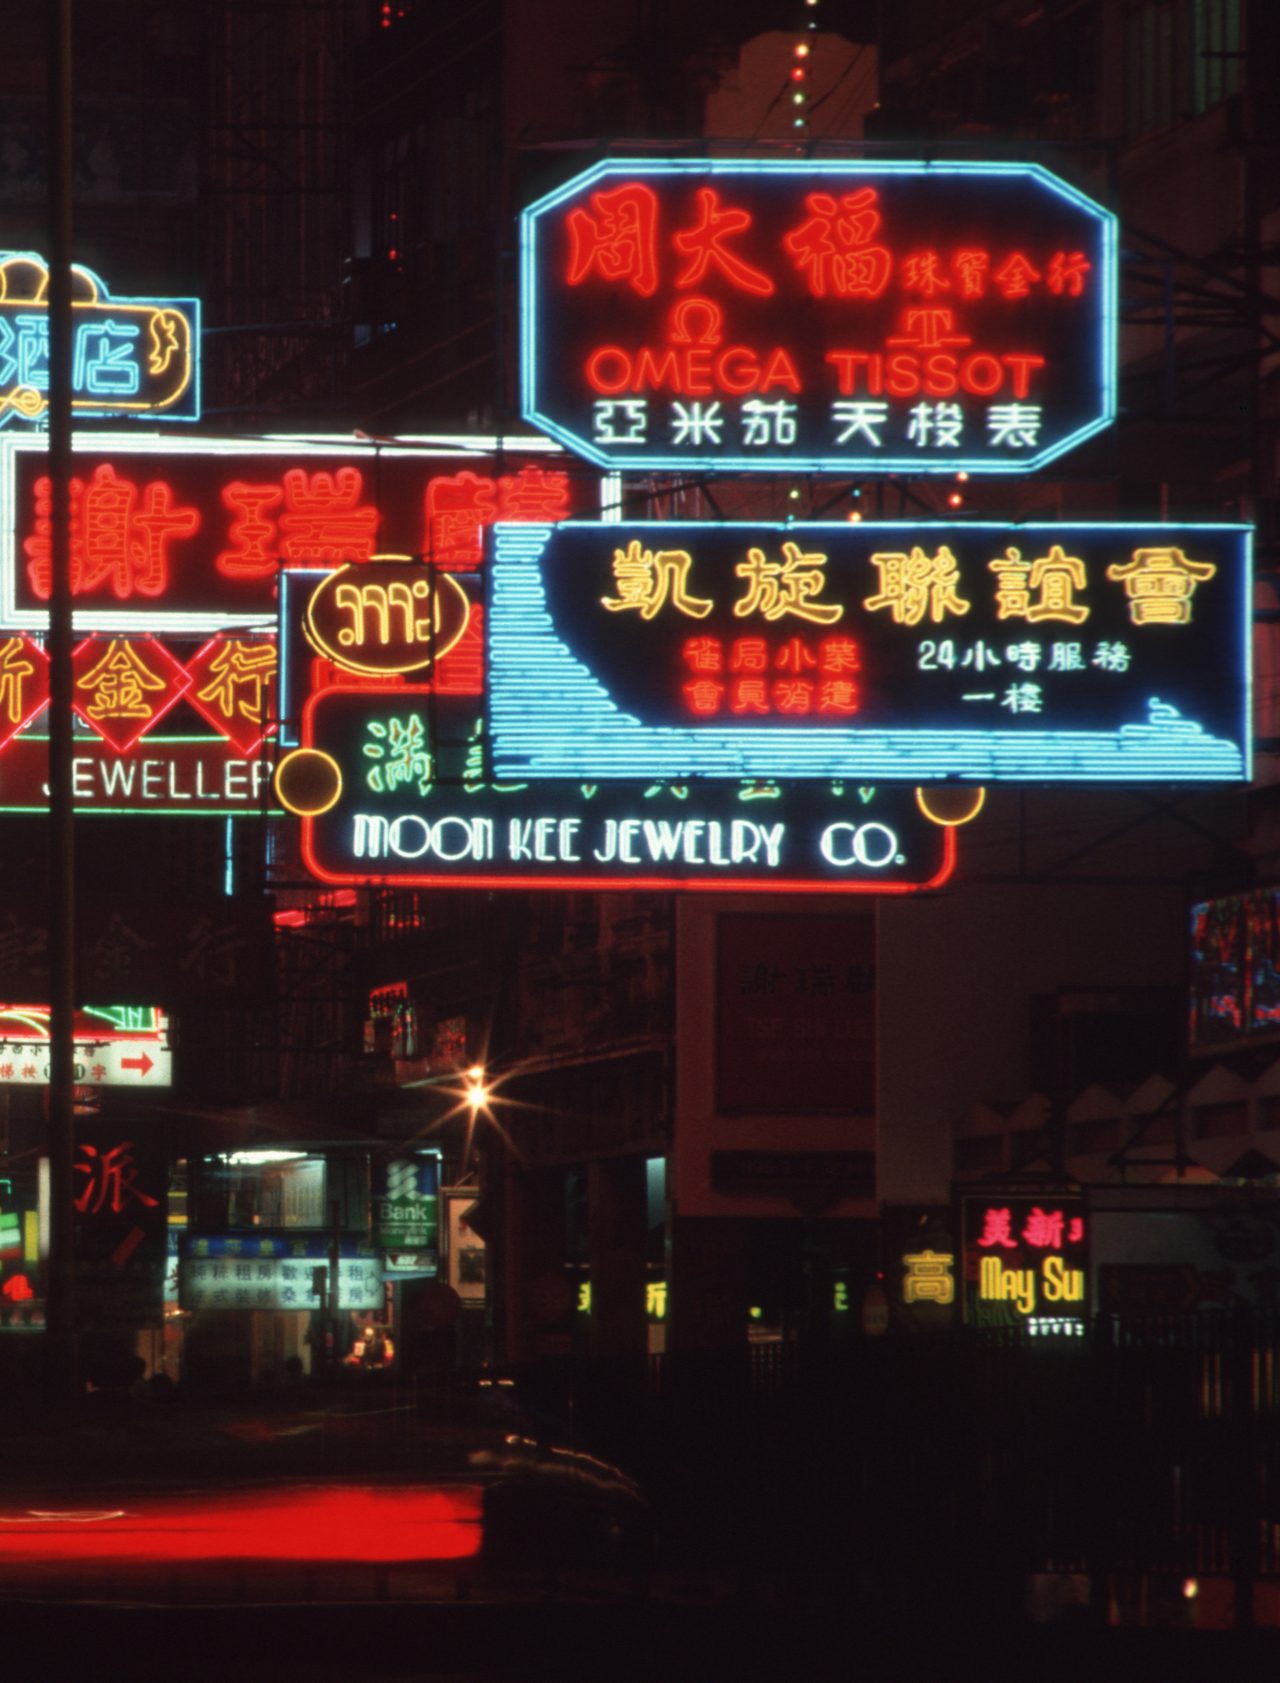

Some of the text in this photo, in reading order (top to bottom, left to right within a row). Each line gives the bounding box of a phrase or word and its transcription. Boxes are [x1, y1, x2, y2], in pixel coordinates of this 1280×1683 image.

[565, 182, 1092, 298] 周大福 珠寶金行
[586, 346, 1045, 398] OMEGA TISSOT
[593, 399, 1043, 447] 亞米茄 天梭表
[601, 540, 1217, 626] 凱旋聯誼會
[917, 639, 1133, 673] 24小時服務
[43, 757, 275, 799] EWELLER
[352, 814, 907, 867] MOON KEE JEWELRY CO.
[381, 1203, 428, 1221] Bank
[903, 1249, 955, 1304] 高
[980, 1256, 1035, 1314] May
